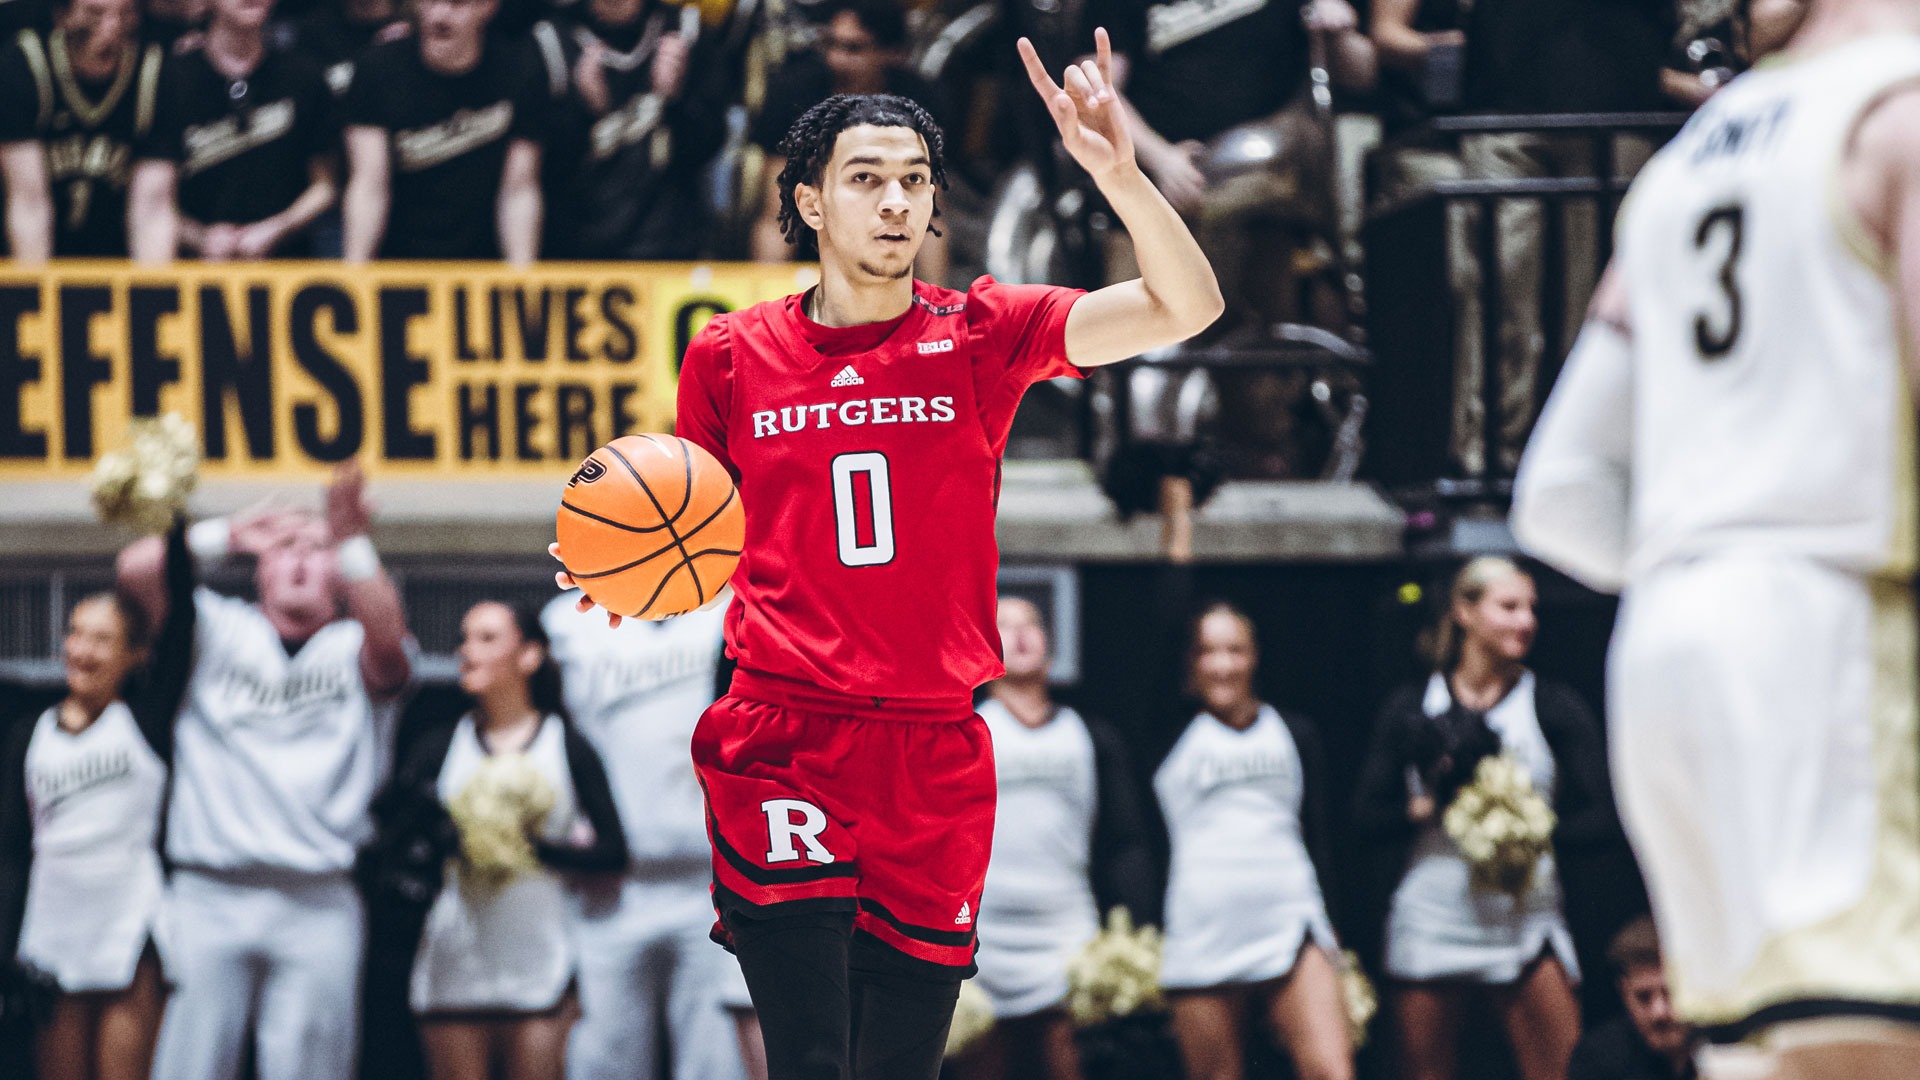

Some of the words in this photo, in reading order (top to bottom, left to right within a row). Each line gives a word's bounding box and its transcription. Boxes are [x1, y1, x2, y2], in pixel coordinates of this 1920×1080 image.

[1693, 203, 1744, 359] 3
[454, 286, 638, 362] LIVES
[752, 396, 956, 439] RUTGERS
[831, 376, 864, 388] adidas
[458, 383, 638, 460] HERE
[830, 451, 896, 568] 0
[761, 798, 836, 864] R
